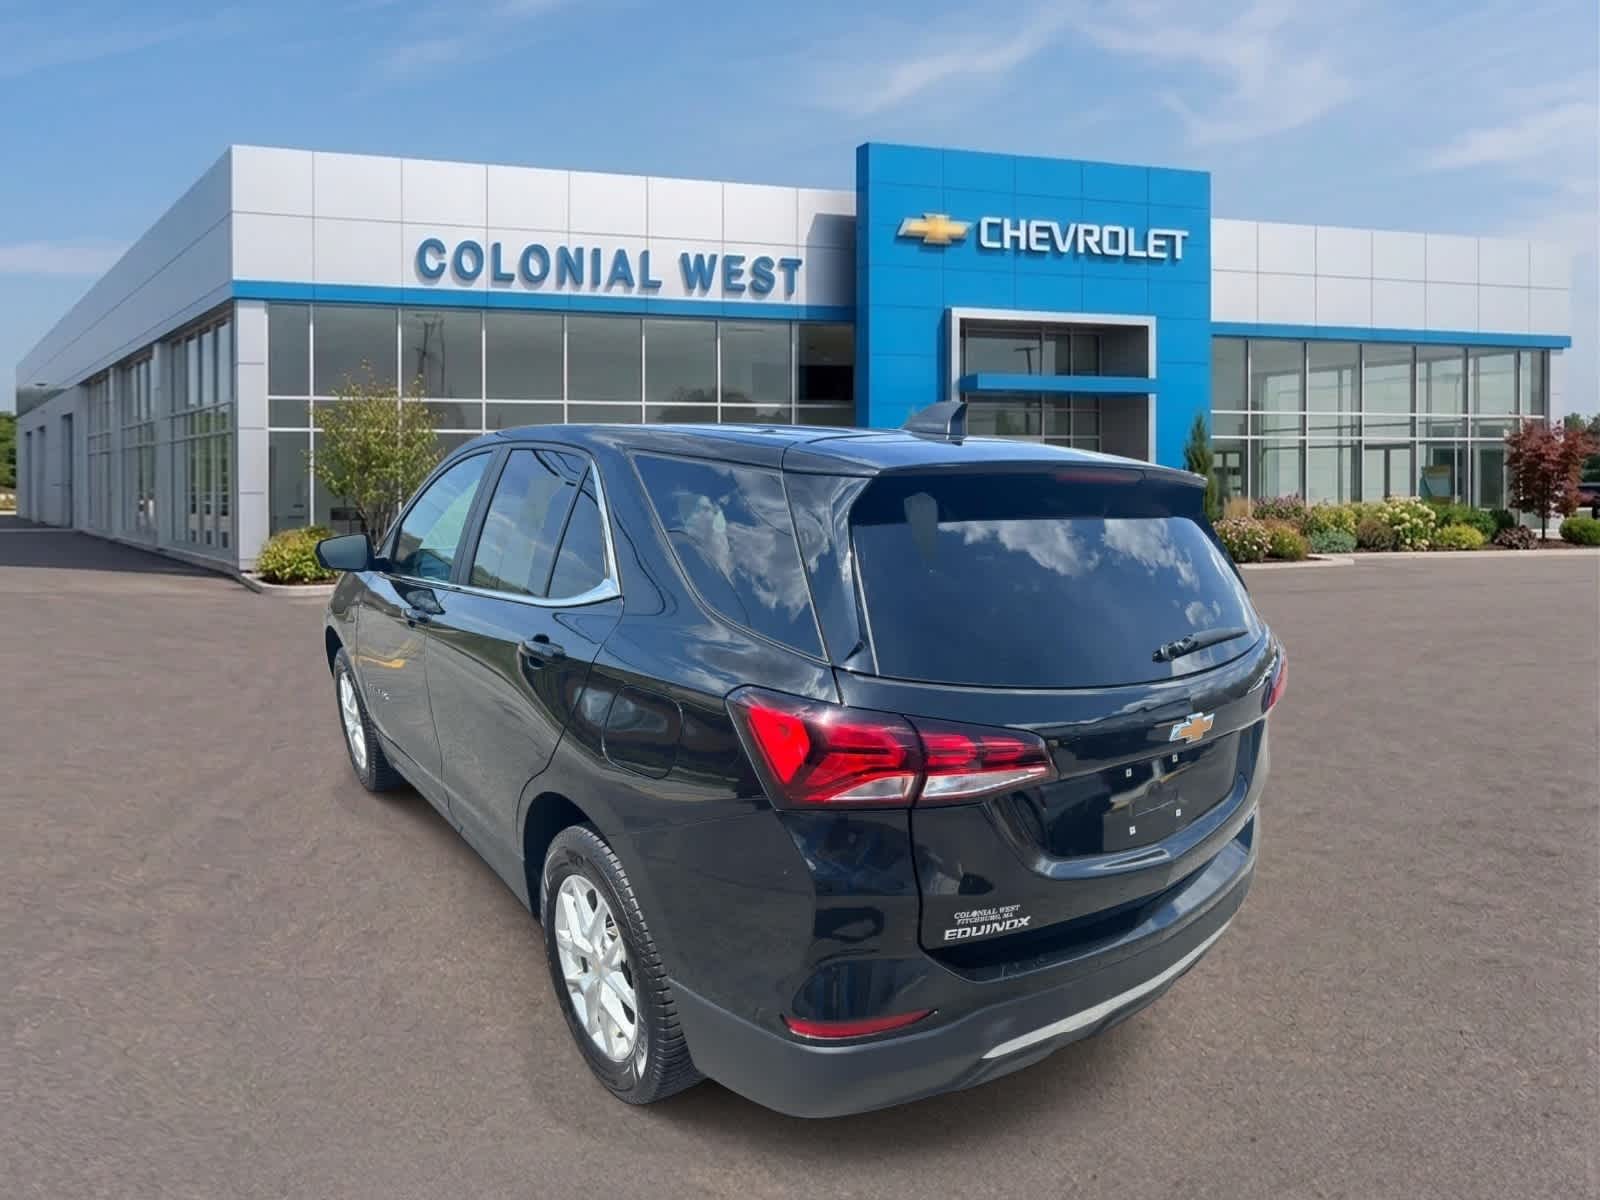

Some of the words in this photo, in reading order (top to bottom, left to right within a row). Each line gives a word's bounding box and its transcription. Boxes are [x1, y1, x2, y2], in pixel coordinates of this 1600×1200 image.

[979, 216, 1189, 261] CHEVROLET
[416, 238, 662, 291] COLONIAL
[680, 251, 803, 299] WEST
[944, 916, 1031, 940] EQUINOX
[954, 908, 998, 920] COLONIAL
